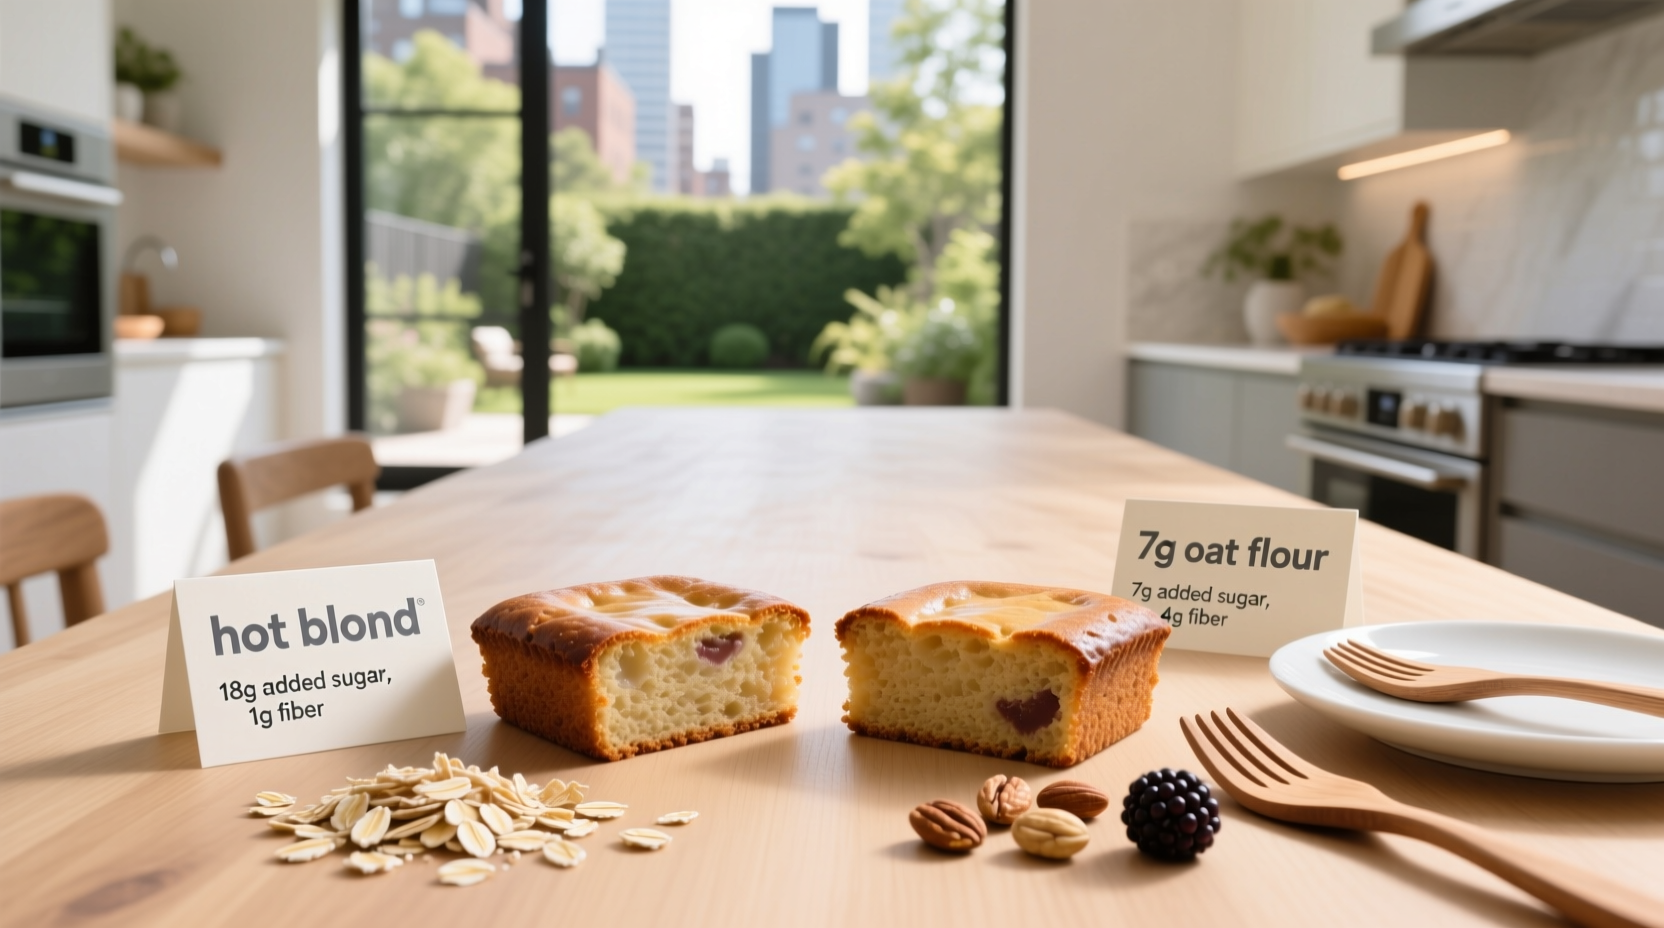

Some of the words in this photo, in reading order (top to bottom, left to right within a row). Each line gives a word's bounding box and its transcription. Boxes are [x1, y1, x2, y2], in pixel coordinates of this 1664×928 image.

[1137, 530, 1177, 569] 7g
[1184, 539, 1240, 566] oat
[1247, 537, 1330, 571] flour
[1131, 582, 1152, 602] 7g
[1157, 584, 1213, 603] added
[1217, 590, 1270, 610] sugar,
[1160, 606, 1183, 628] 4g
[1188, 608, 1228, 627] fiber
[210, 613, 290, 657] hot
[219, 680, 257, 703] 18g
[262, 670, 326, 696] added
[331, 667, 392, 690] sugar,
[248, 707, 273, 729] 1g
[277, 700, 325, 722] fiber
